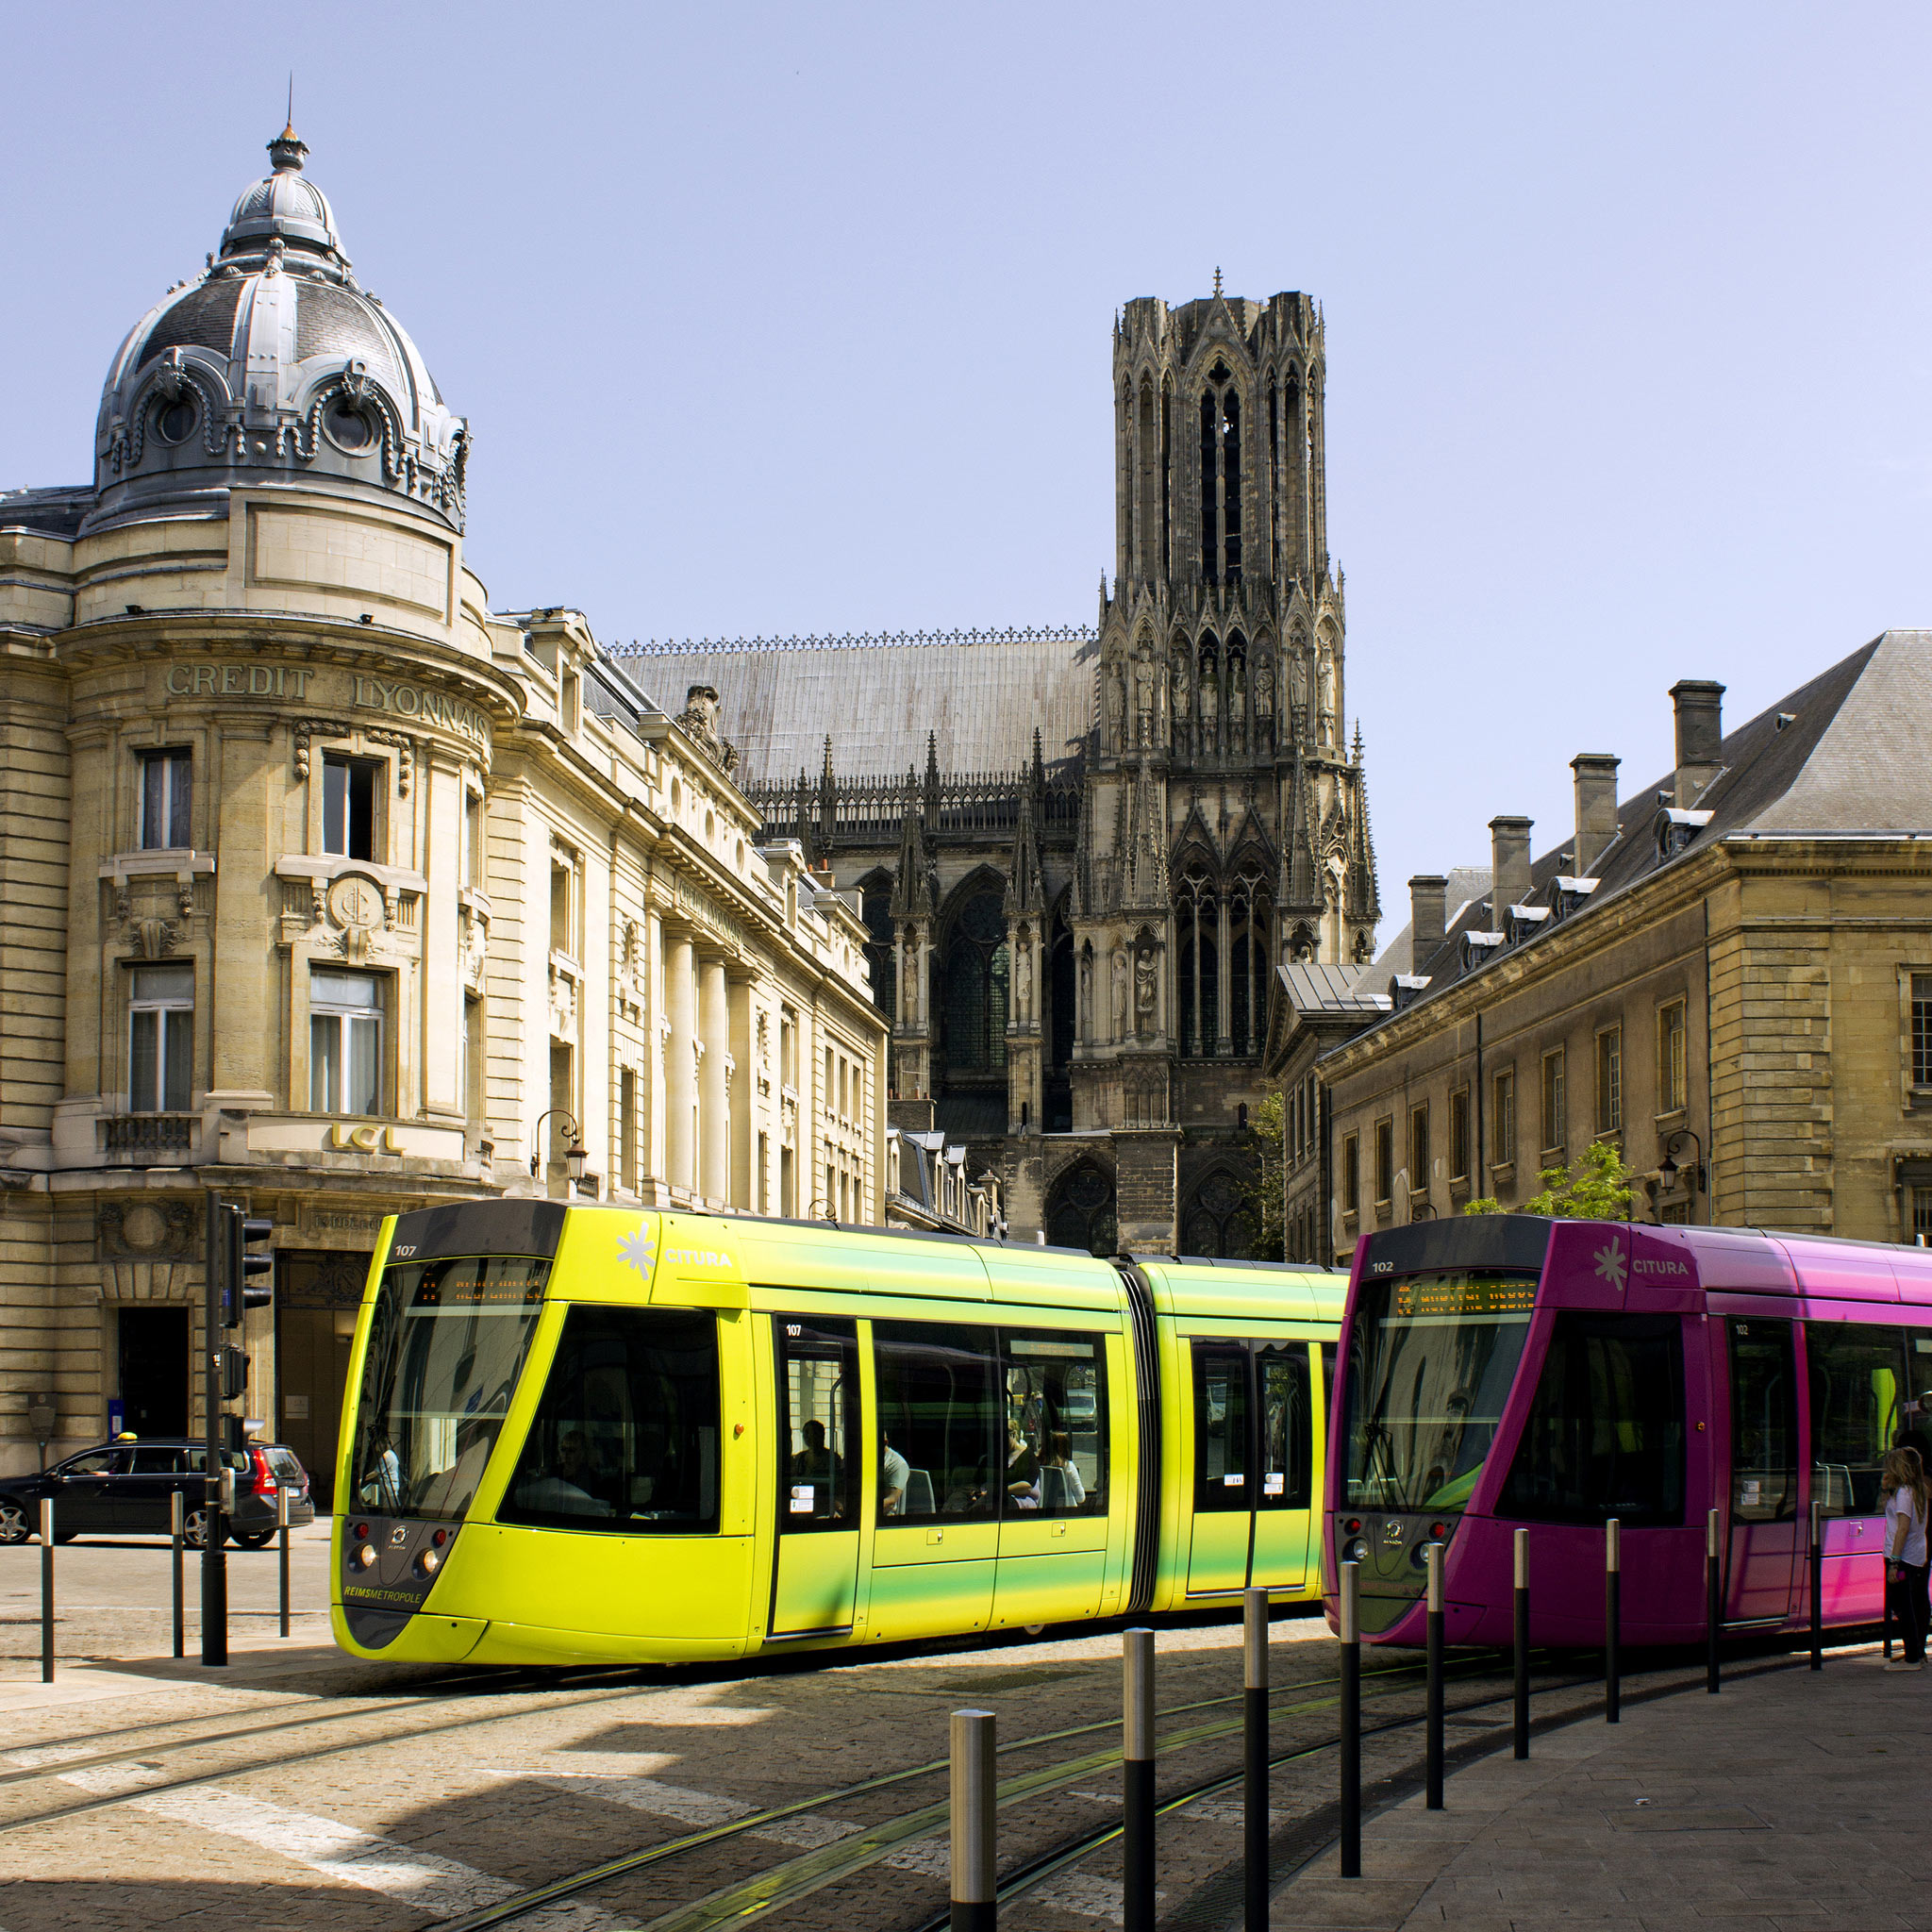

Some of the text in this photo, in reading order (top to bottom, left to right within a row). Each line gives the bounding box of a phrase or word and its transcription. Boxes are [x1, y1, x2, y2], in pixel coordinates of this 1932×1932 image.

[166, 664, 489, 743] CREDIT LYONNAIS
[331, 1122, 407, 1152] LCL
[394, 1244, 417, 1257] 107
[664, 1248, 733, 1267] CITURA
[1372, 1261, 1394, 1274] 102
[1632, 1259, 1690, 1274] CITURA
[786, 1324, 801, 1337] 107
[1736, 1324, 1749, 1336] 102
